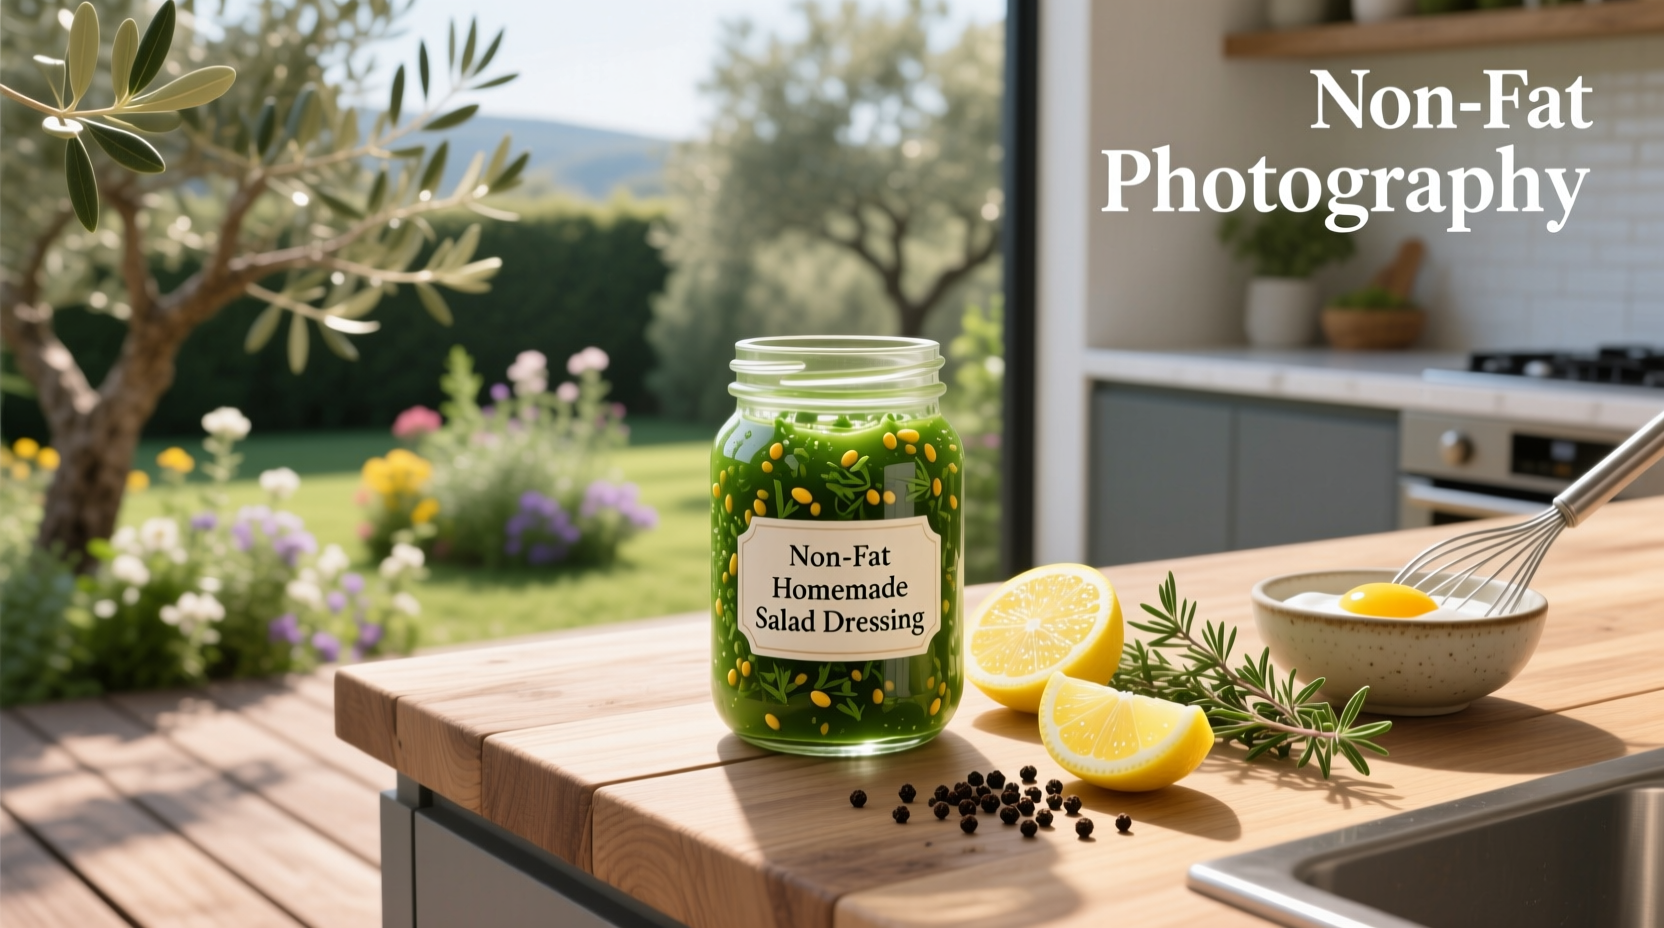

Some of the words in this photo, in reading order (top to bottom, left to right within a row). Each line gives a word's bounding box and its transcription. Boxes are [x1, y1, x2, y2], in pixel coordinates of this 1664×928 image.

[789, 544, 891, 567] Non-Fat
[772, 575, 908, 601] Homemade
[755, 606, 816, 633] Salad
[823, 608, 925, 636] Dressing
